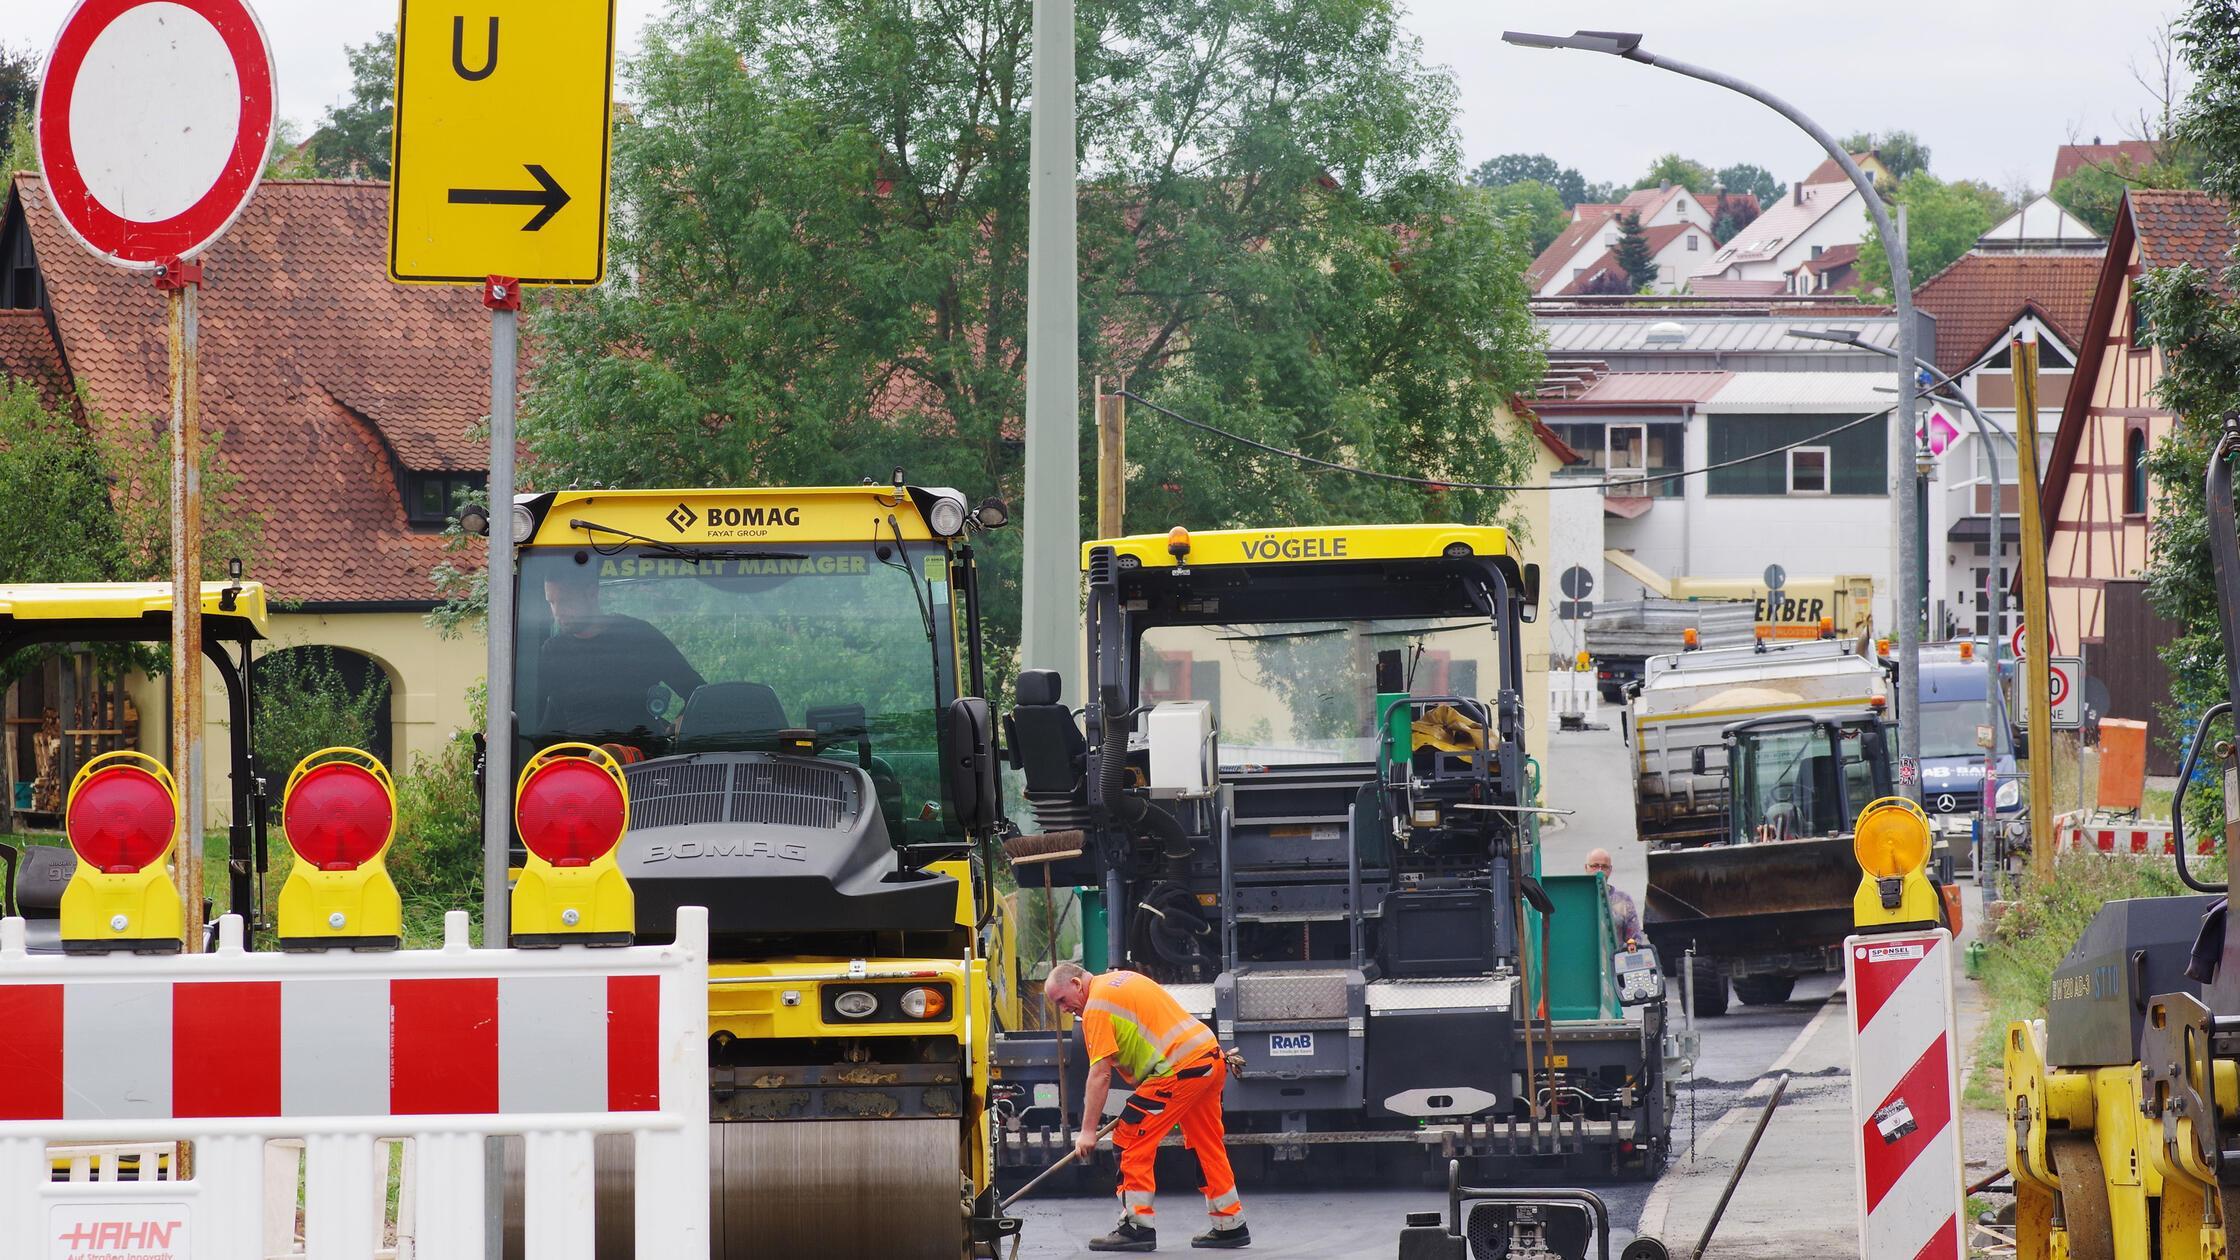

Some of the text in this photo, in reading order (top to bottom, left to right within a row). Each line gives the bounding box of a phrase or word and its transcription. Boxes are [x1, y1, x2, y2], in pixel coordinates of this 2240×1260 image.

[452, 15, 499, 81] U
[707, 507, 800, 527] BOMAG
[736, 529, 768, 537] GROUP
[1241, 534, 1348, 560] VÖGELE
[600, 555, 867, 578] ASPHALT MANAGER
[1727, 598, 1824, 622] ERBER
[643, 839, 807, 864] BOMAG
[1272, 1034, 1311, 1049] RAAB
[58, 1220, 182, 1250] HAHN
